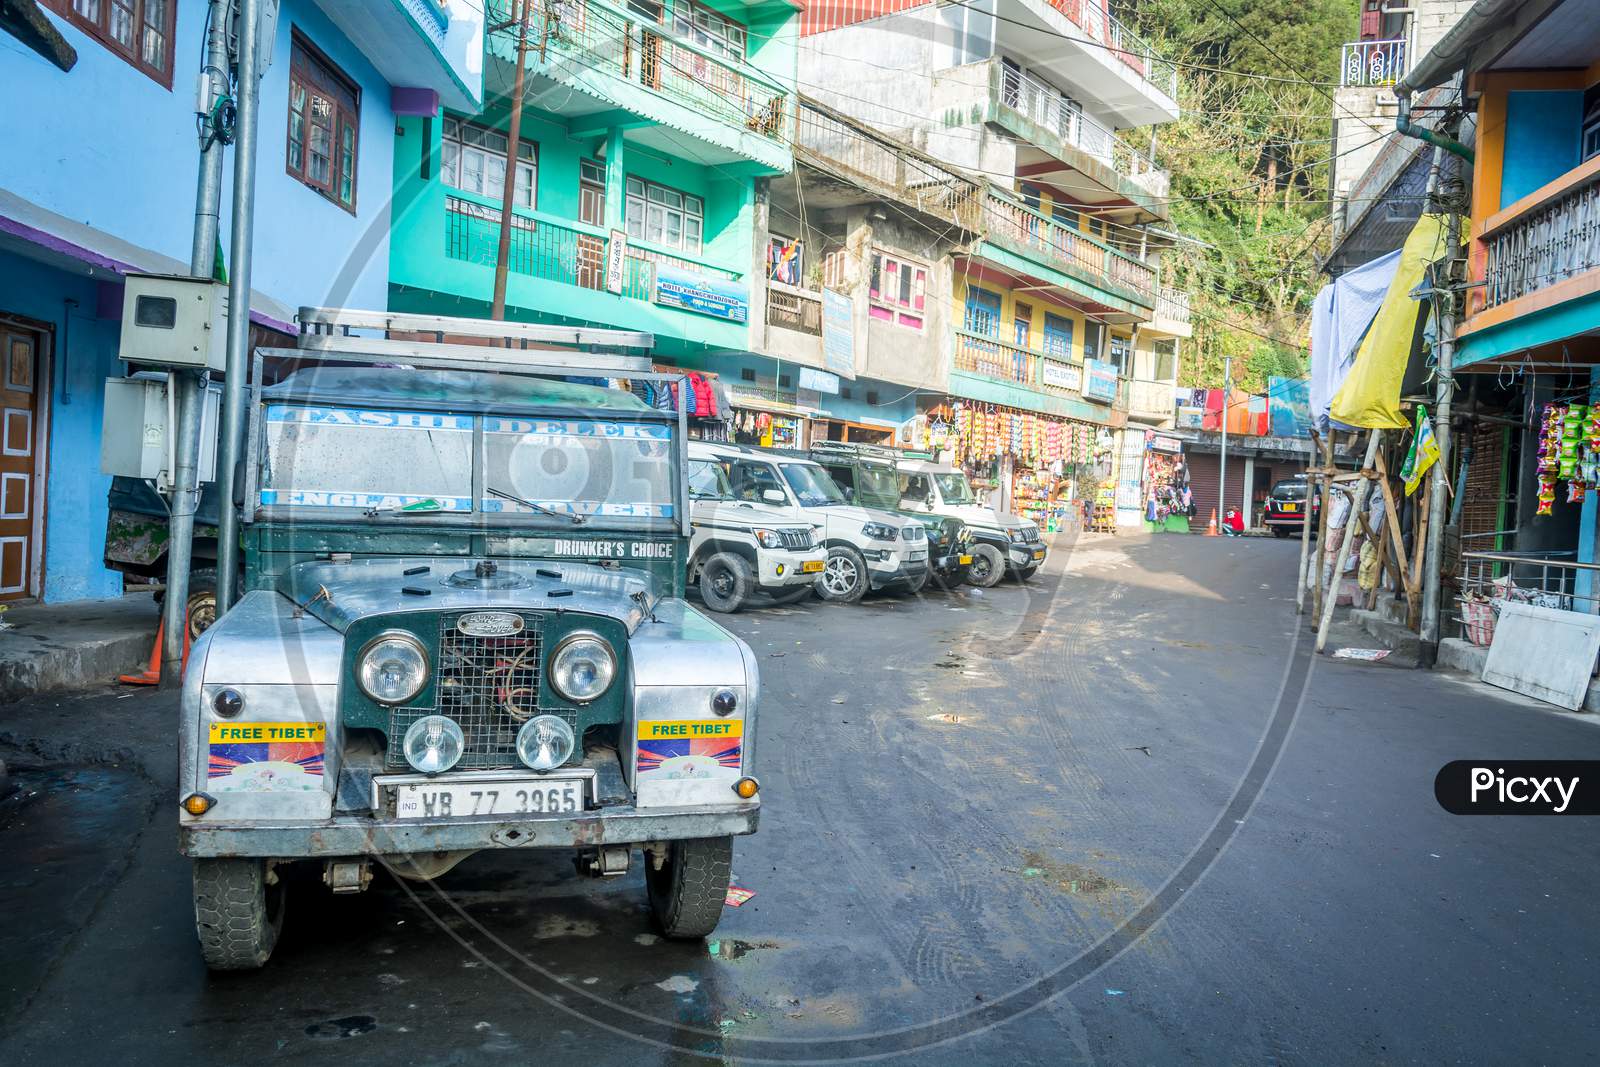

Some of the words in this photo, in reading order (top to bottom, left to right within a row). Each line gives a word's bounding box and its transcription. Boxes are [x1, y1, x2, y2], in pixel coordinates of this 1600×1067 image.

[300, 409, 458, 429] TASHI
[498, 419, 664, 439] DELEK
[554, 540, 625, 557] DRUNKER'S
[631, 542, 673, 558] CHOICE
[220, 728, 263, 739] FREE
[268, 728, 316, 738] TIBET
[652, 724, 687, 736] FREE
[691, 724, 731, 735] TIBET
[402, 802, 416, 811] IND
[422, 792, 453, 818] WB
[470, 791, 500, 816] 77
[515, 788, 576, 813] 3965
